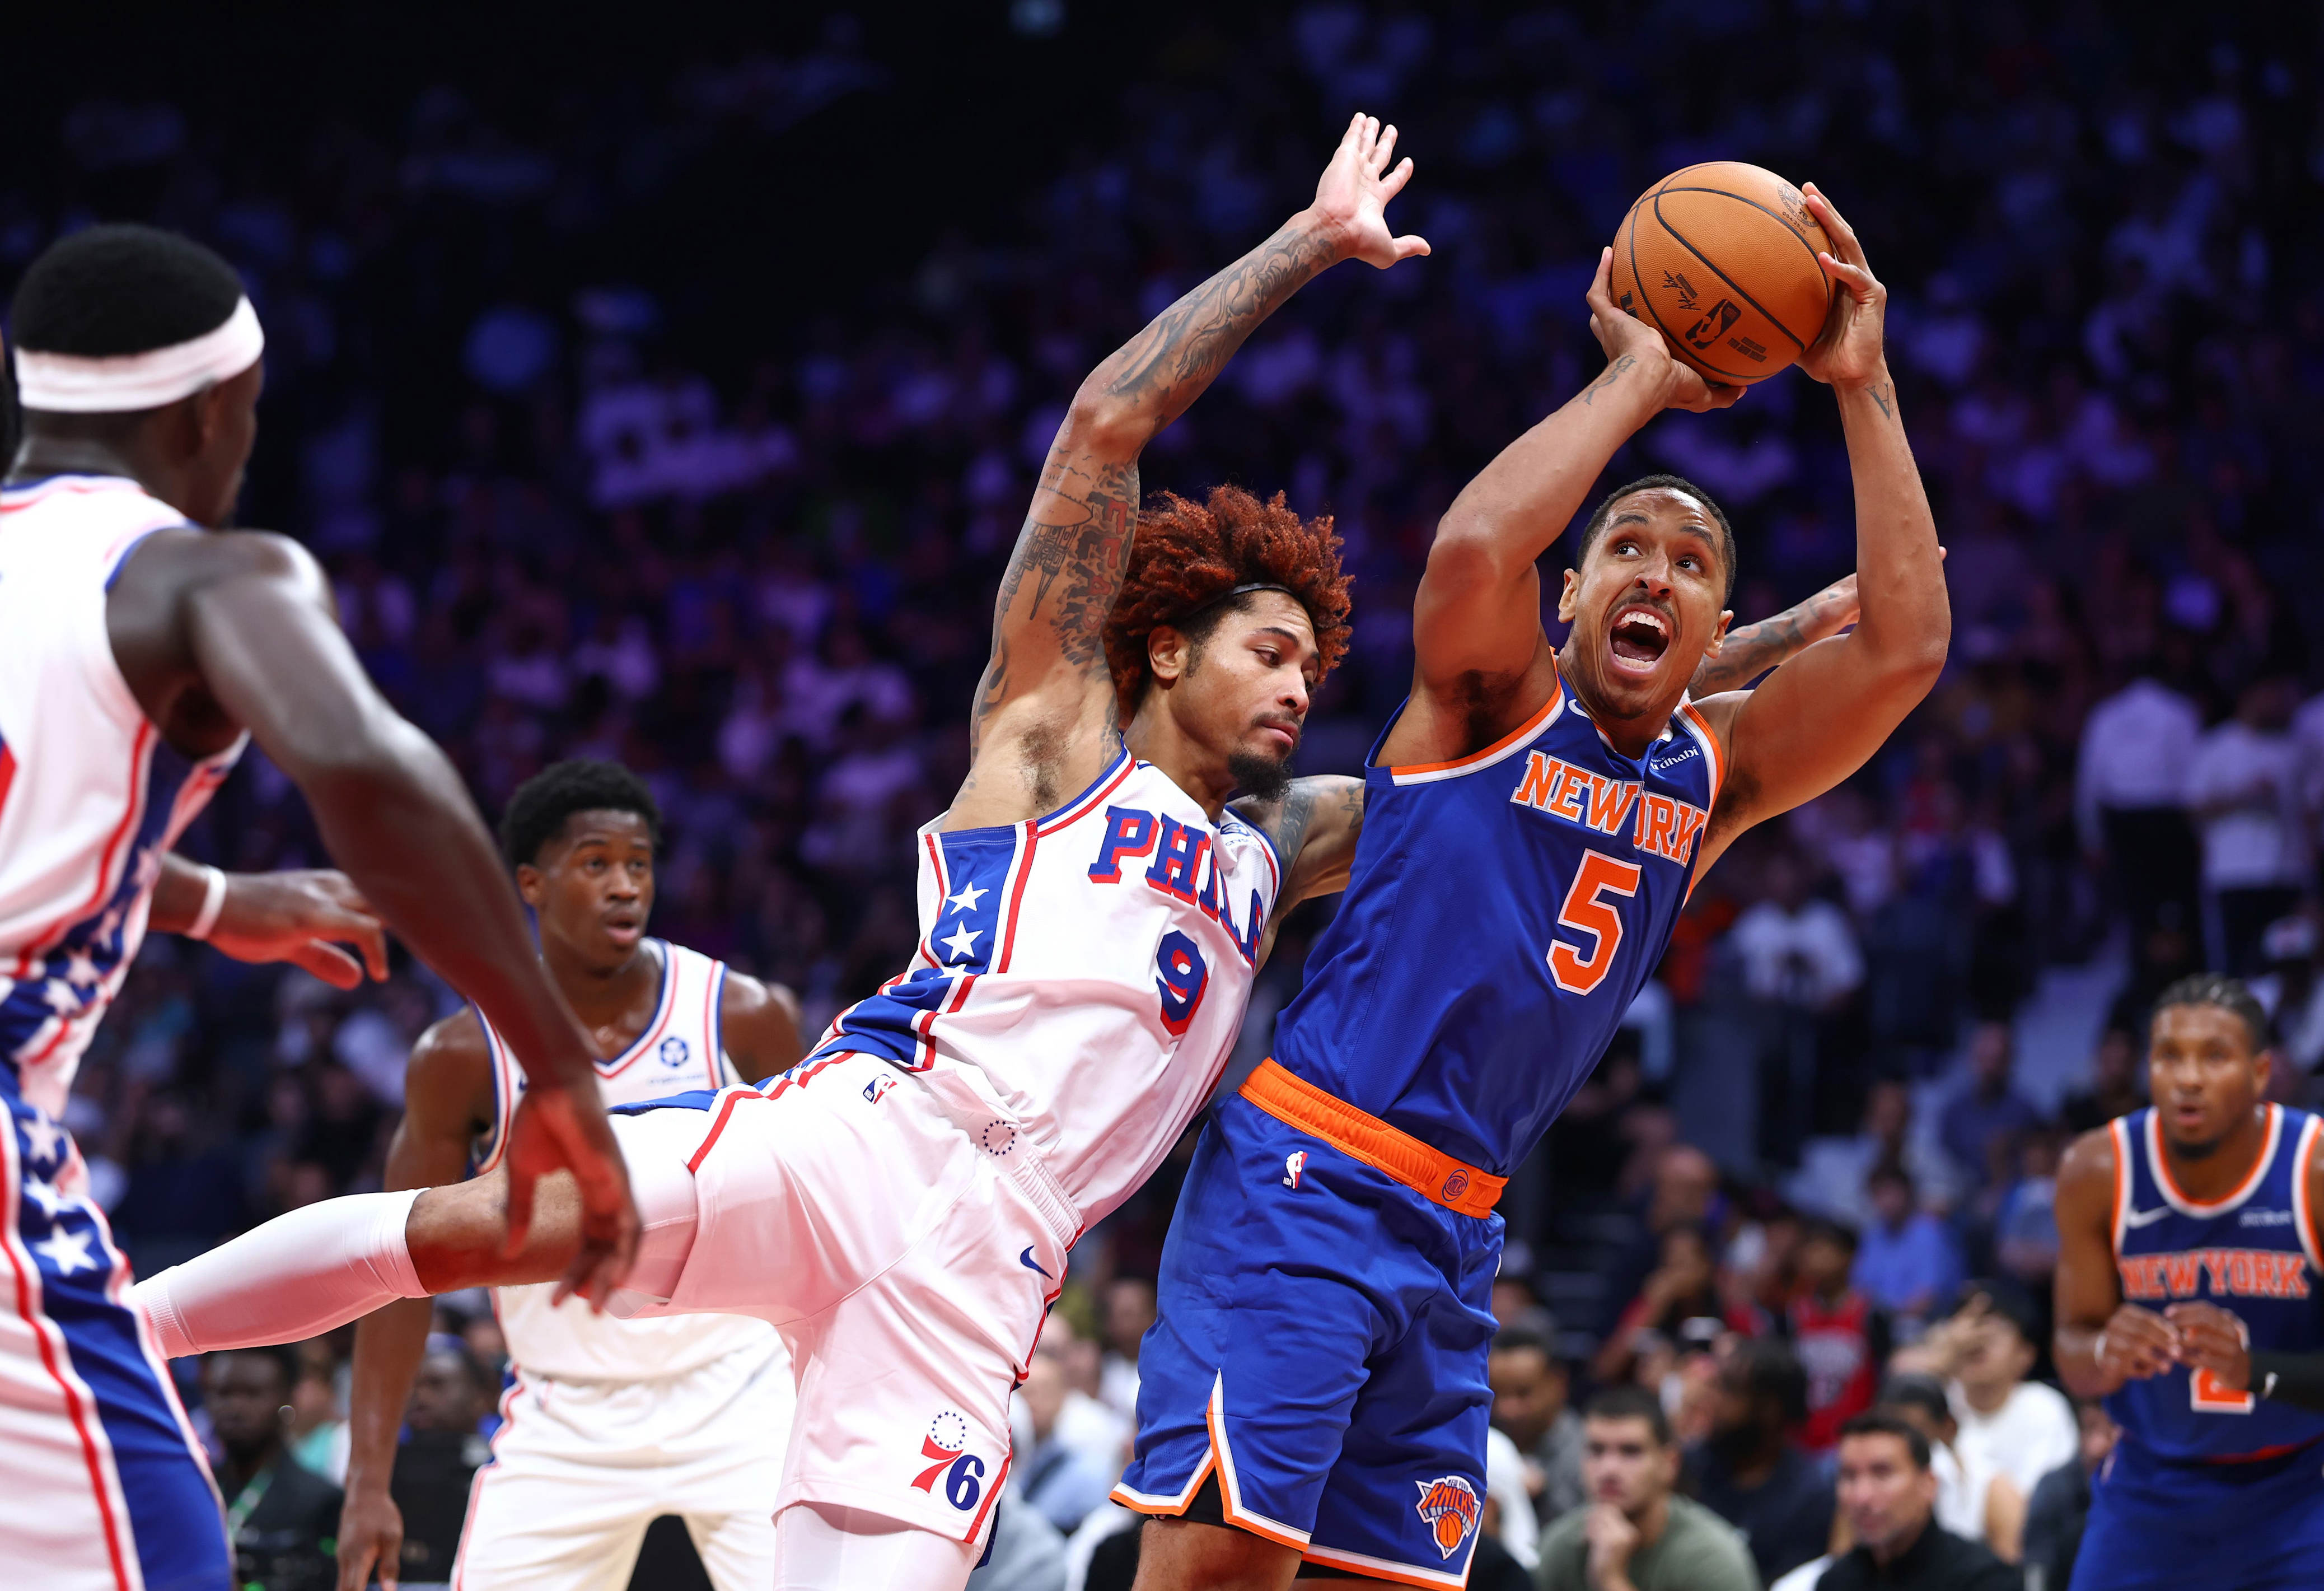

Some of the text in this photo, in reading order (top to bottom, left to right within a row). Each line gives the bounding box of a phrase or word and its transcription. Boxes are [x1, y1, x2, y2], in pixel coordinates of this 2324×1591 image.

[1659, 746, 1699, 769] dhabi
[1511, 749, 1645, 836] NEW
[1546, 848, 1642, 996] 5
[1156, 930, 1209, 1037] 9
[1283, 1177, 1292, 1187] NBA
[2120, 1248, 2310, 1299] NEW YORK
[910, 1433, 985, 1511] 76
[1420, 1482, 1475, 1527] KNICKS
